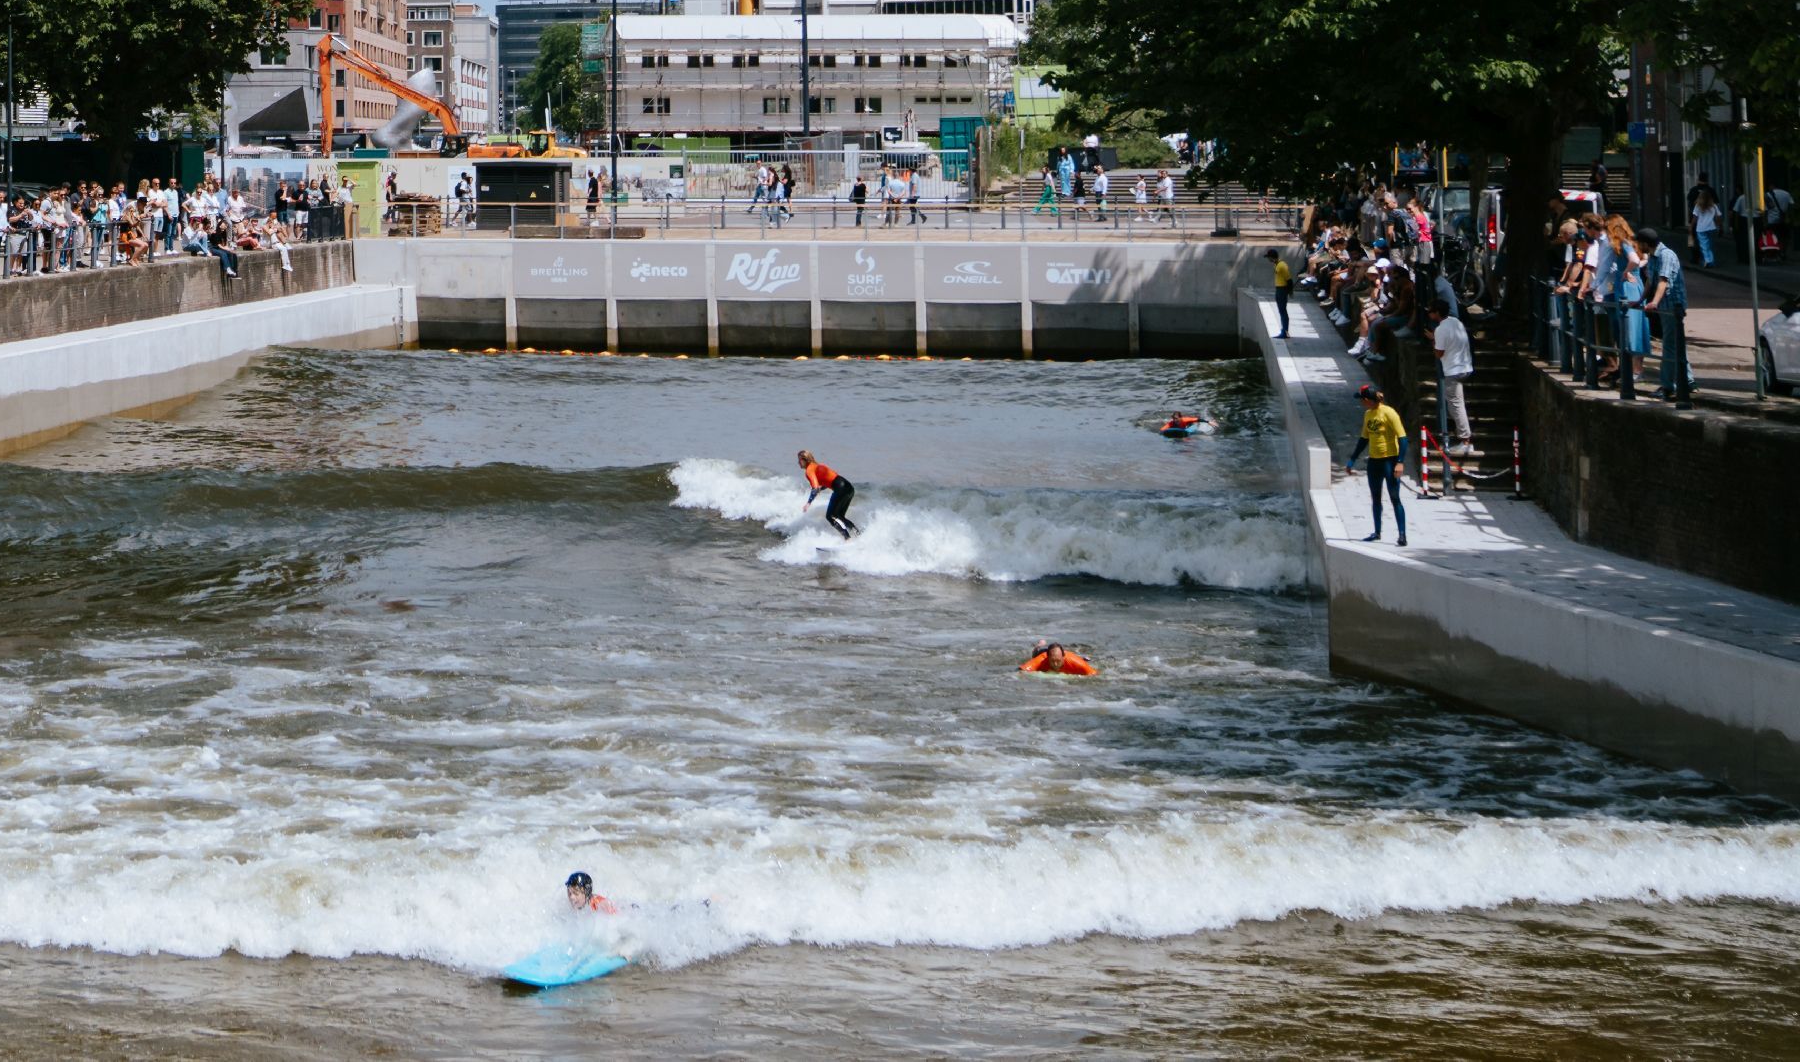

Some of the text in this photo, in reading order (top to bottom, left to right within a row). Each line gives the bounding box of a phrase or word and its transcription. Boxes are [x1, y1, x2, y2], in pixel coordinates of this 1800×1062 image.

[530, 268, 588, 276] BREITLING
[641, 263, 688, 277] Eneco
[847, 274, 884, 284] SURF
[943, 275, 1003, 284] O'NEILL
[1046, 268, 1112, 284] OATLY!
[847, 285, 885, 296] LOCH
